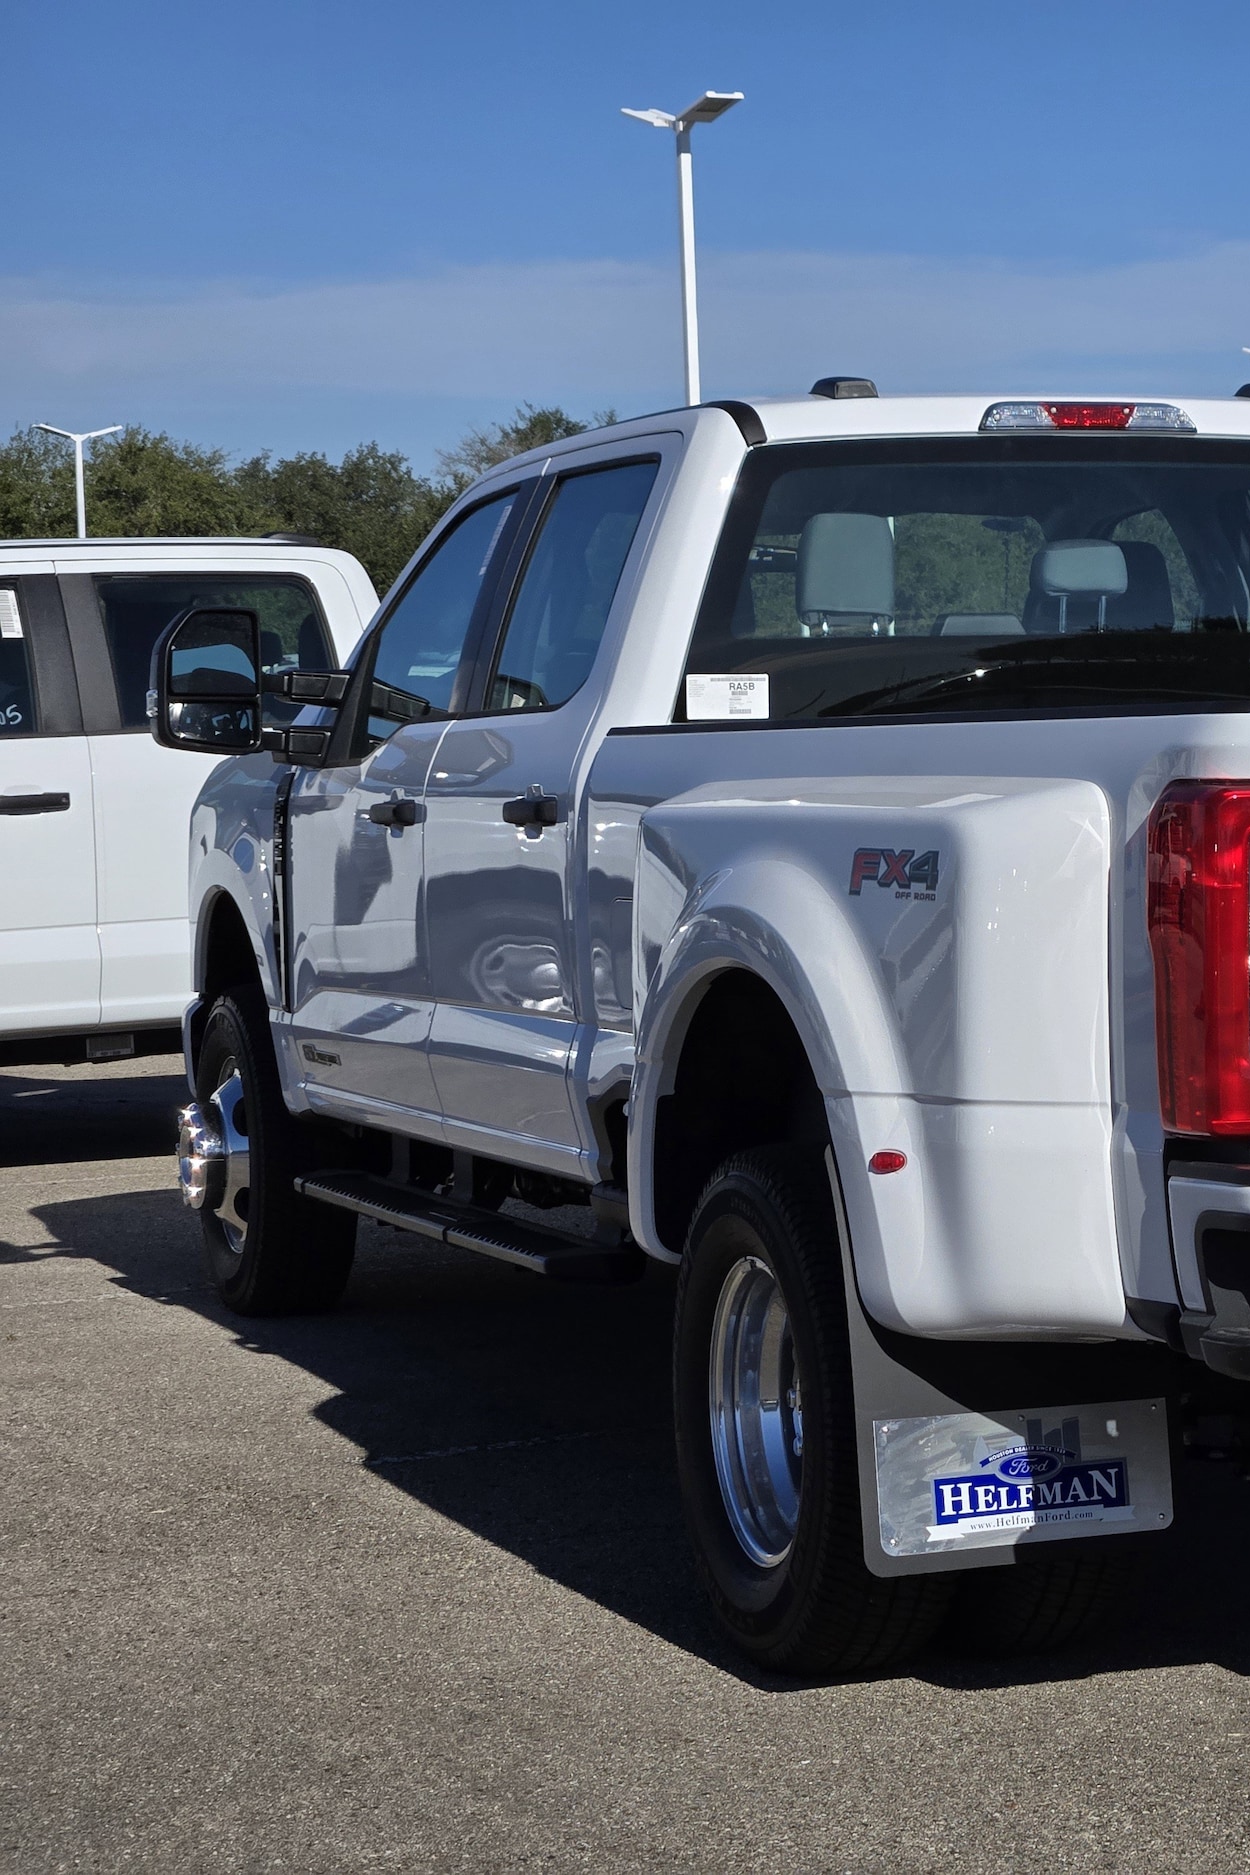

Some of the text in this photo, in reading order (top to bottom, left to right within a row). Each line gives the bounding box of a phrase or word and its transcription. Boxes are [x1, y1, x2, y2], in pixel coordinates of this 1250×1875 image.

[729, 682, 755, 691] RA5B
[849, 847, 939, 896] FX4
[895, 891, 936, 901] OFF ROAD
[989, 1448, 1014, 1462] HOUSTON
[1009, 1458, 1049, 1475] Ford
[939, 1468, 1119, 1516] HELFMAN
[969, 1510, 1094, 1531] www.HelfmanFord.com
